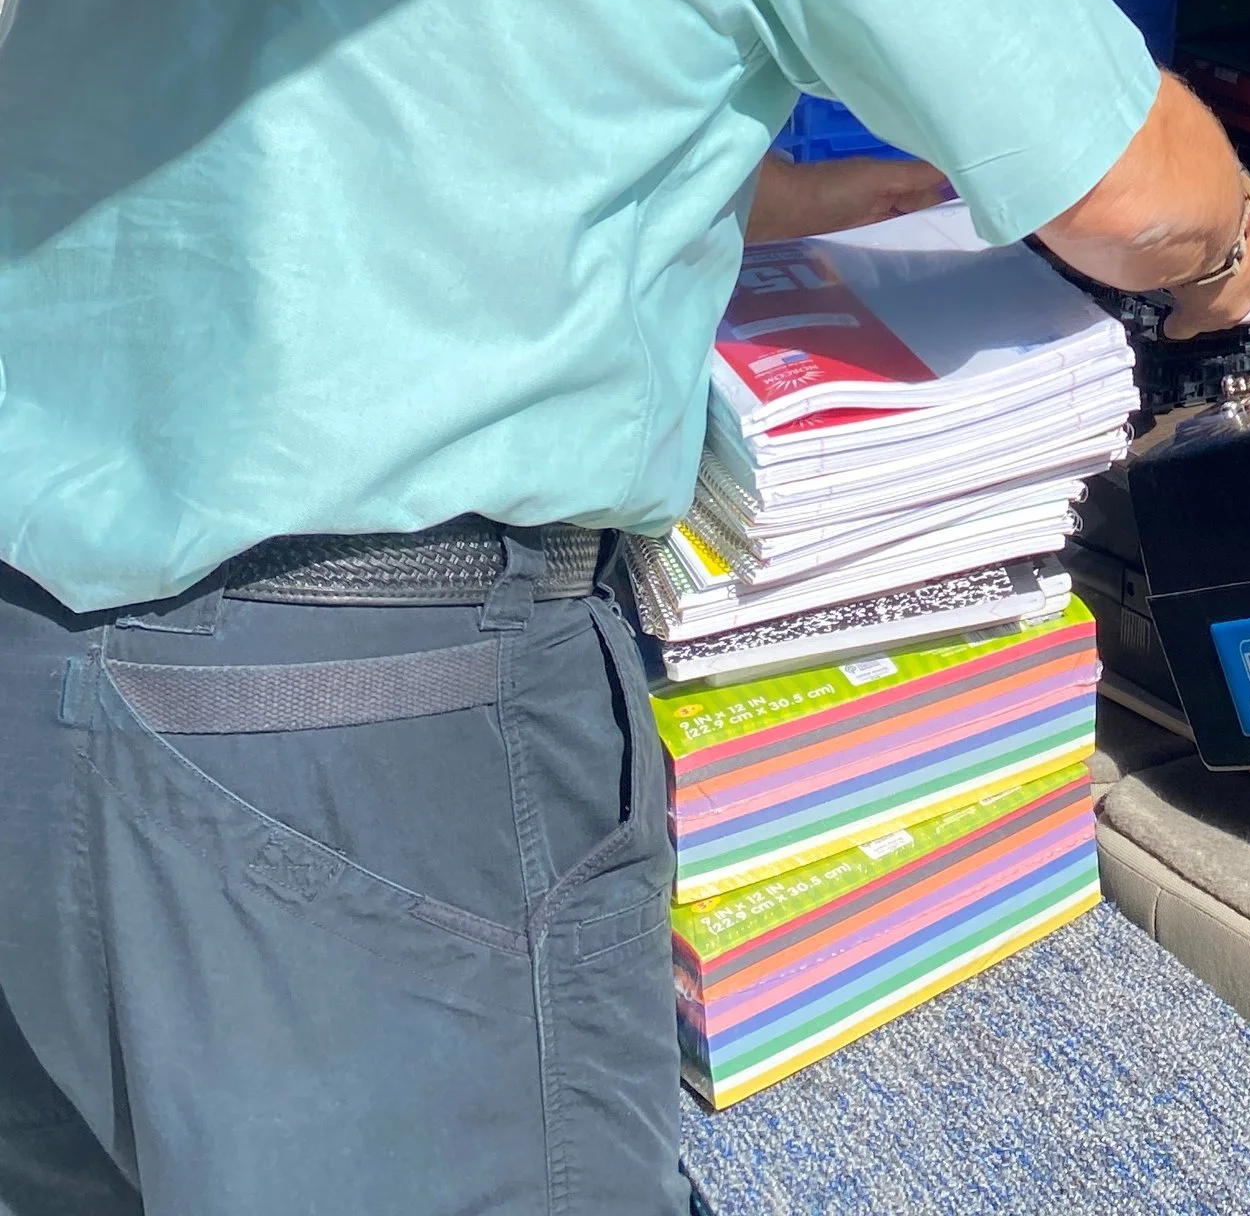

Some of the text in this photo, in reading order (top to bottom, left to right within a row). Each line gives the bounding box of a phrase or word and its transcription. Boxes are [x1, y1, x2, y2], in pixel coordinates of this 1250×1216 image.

[762, 364, 819, 385] NORCOM
[679, 721, 690, 730] 9
[693, 714, 713, 727] IN
[727, 703, 746, 715] 12
[748, 696, 767, 708] IN
[684, 719, 724, 741] (22.9
[729, 712, 754, 725] cm
[768, 693, 803, 712] 30.5
[807, 683, 836, 699] cm)
[700, 917, 711, 927] 9
[713, 907, 734, 920] IN
[745, 892, 766, 905] 12
[765, 882, 786, 896] IN
[707, 911, 747, 936] (22.9
[750, 900, 775, 915] cm
[787, 875, 822, 897] 30.5
[824, 862, 852, 880] cm)
